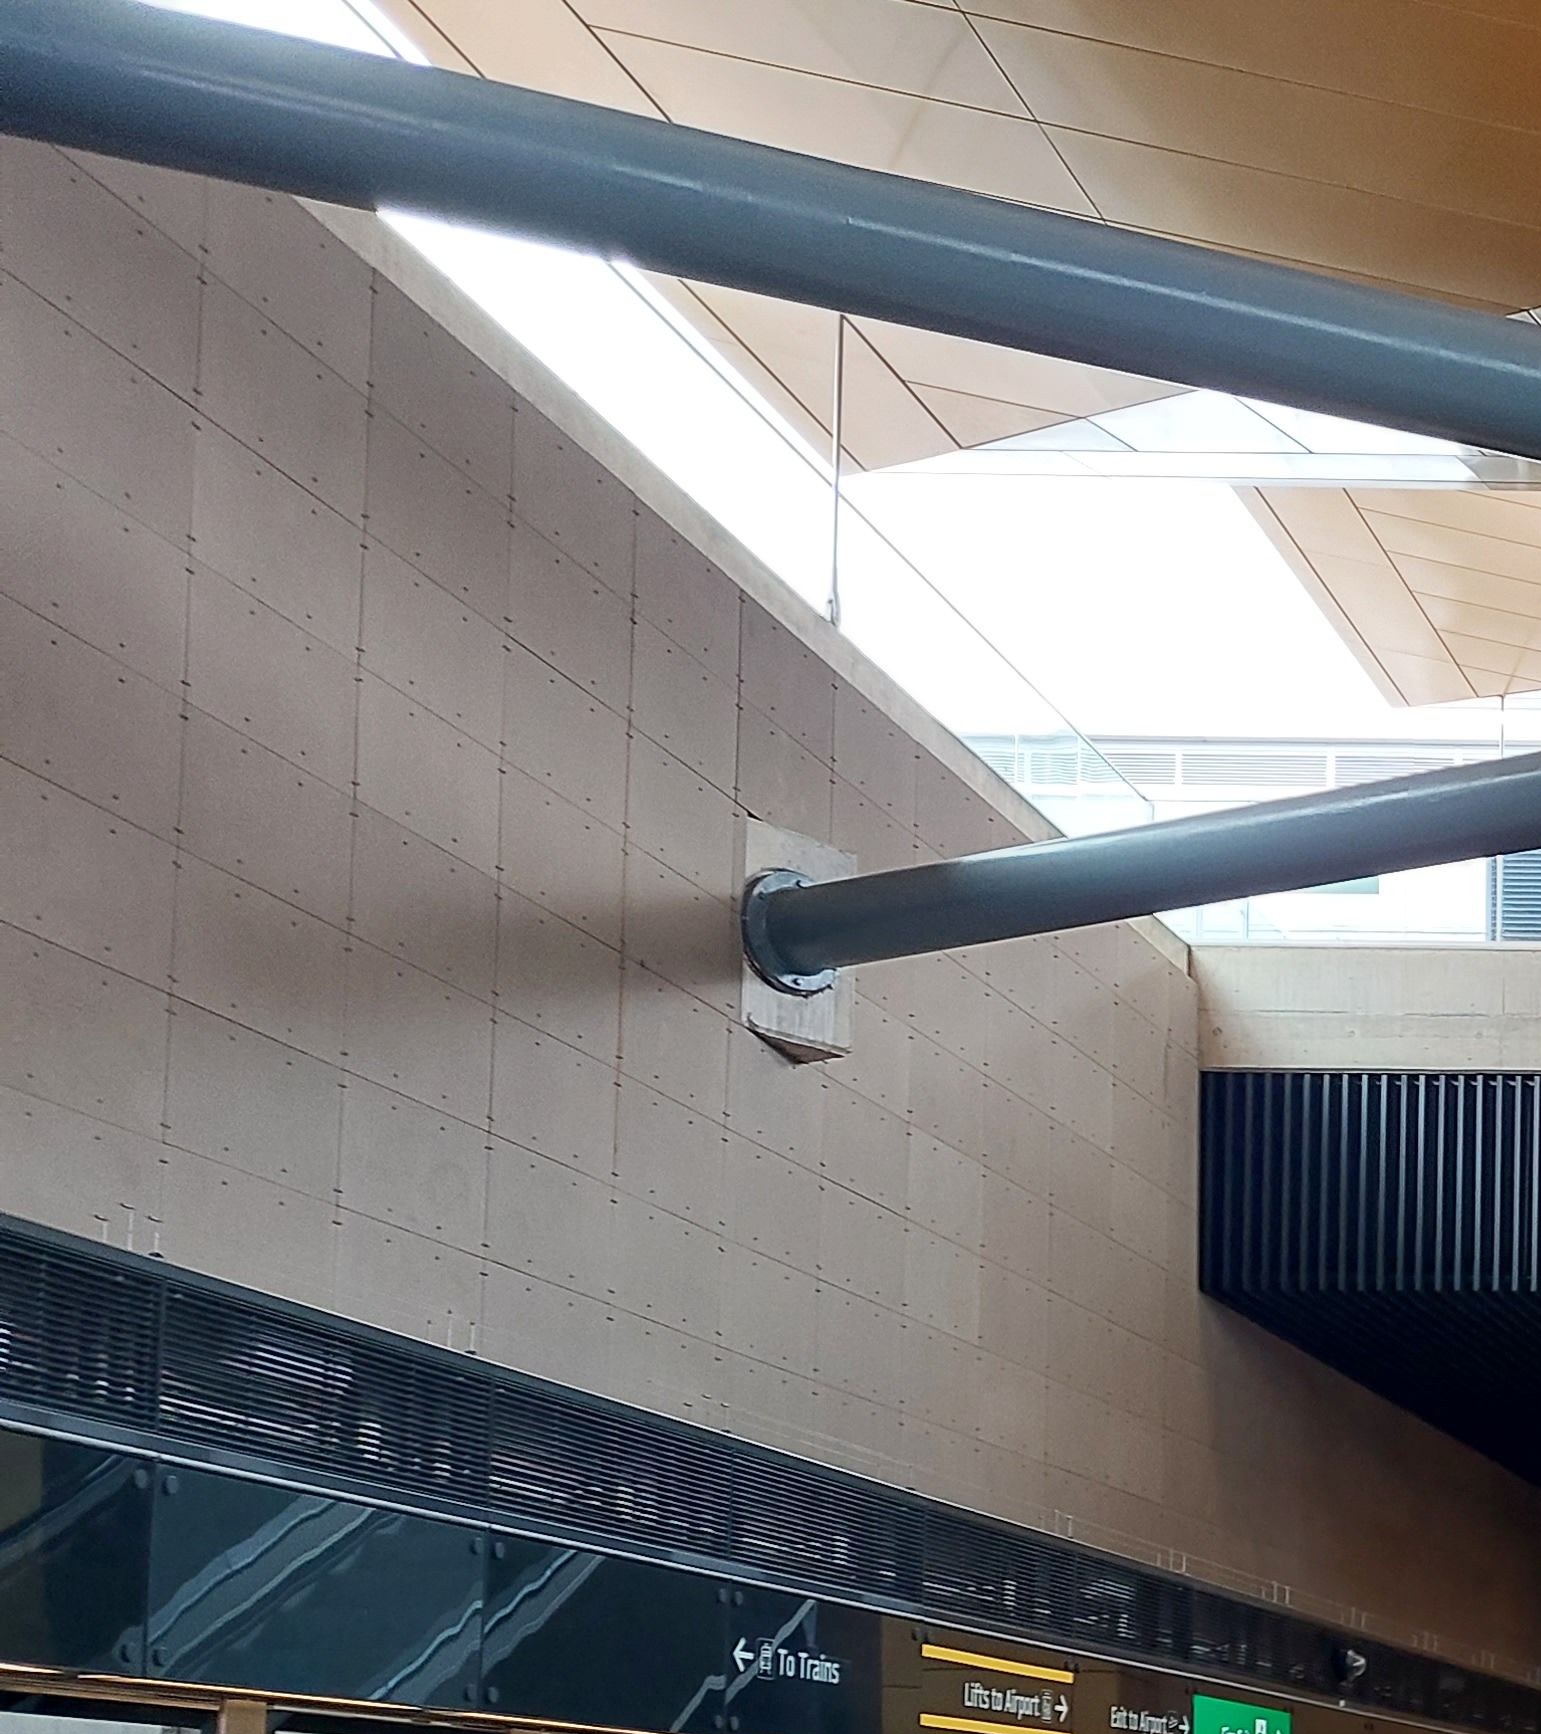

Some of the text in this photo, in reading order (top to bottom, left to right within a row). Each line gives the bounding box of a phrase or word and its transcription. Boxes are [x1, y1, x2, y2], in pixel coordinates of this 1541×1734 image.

[777, 1648, 841, 1684] To Trains
[964, 1682, 1041, 1720] Lifts to Airport
[1110, 1705, 1128, 1729] Exit
[1129, 1711, 1139, 1730] to
